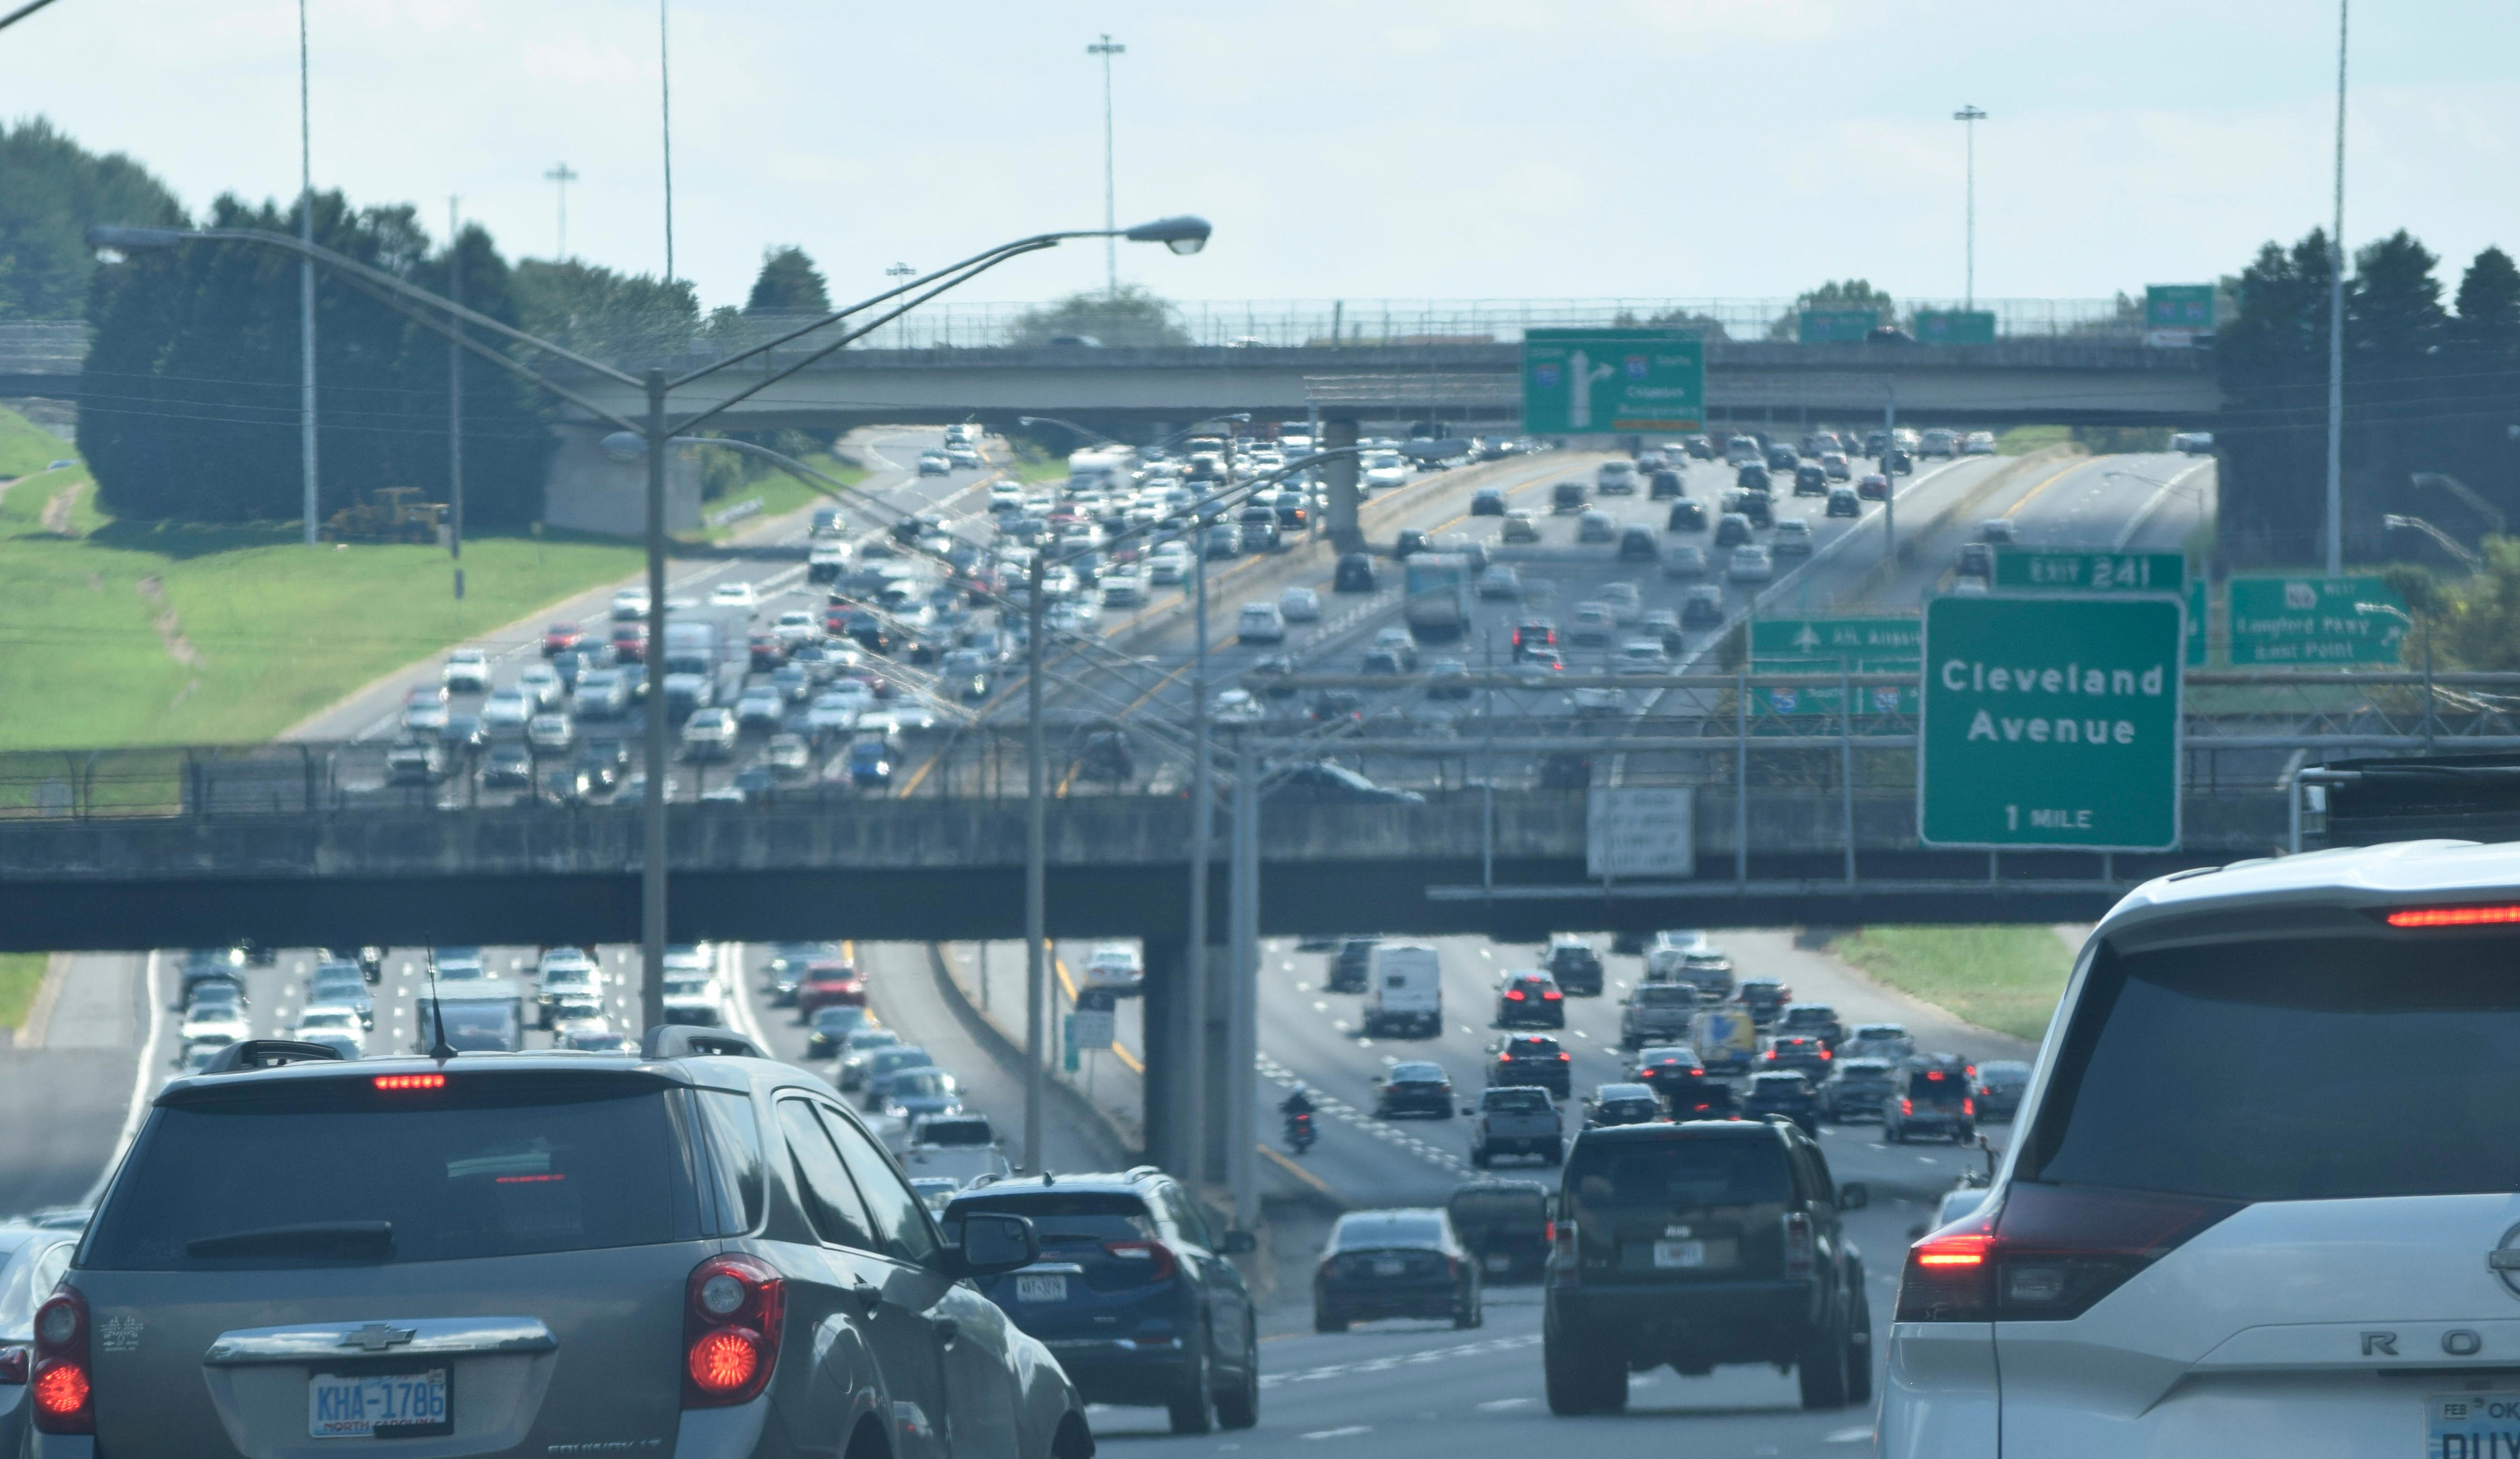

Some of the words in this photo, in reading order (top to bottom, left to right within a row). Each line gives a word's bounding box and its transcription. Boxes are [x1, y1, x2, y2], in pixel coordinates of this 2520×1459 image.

[2029, 558, 2080, 583] EXIT
[2092, 558, 2151, 588] 241
[1942, 659, 2163, 695] Cleveland
[1967, 708, 2136, 744] Avenue
[2006, 805, 2019, 831] 1
[2030, 809, 2093, 828] MILE
[317, 1382, 444, 1422] KHA-1786
[2445, 1403, 2466, 1415] FEB
[323, 1421, 370, 1432] NORTH
